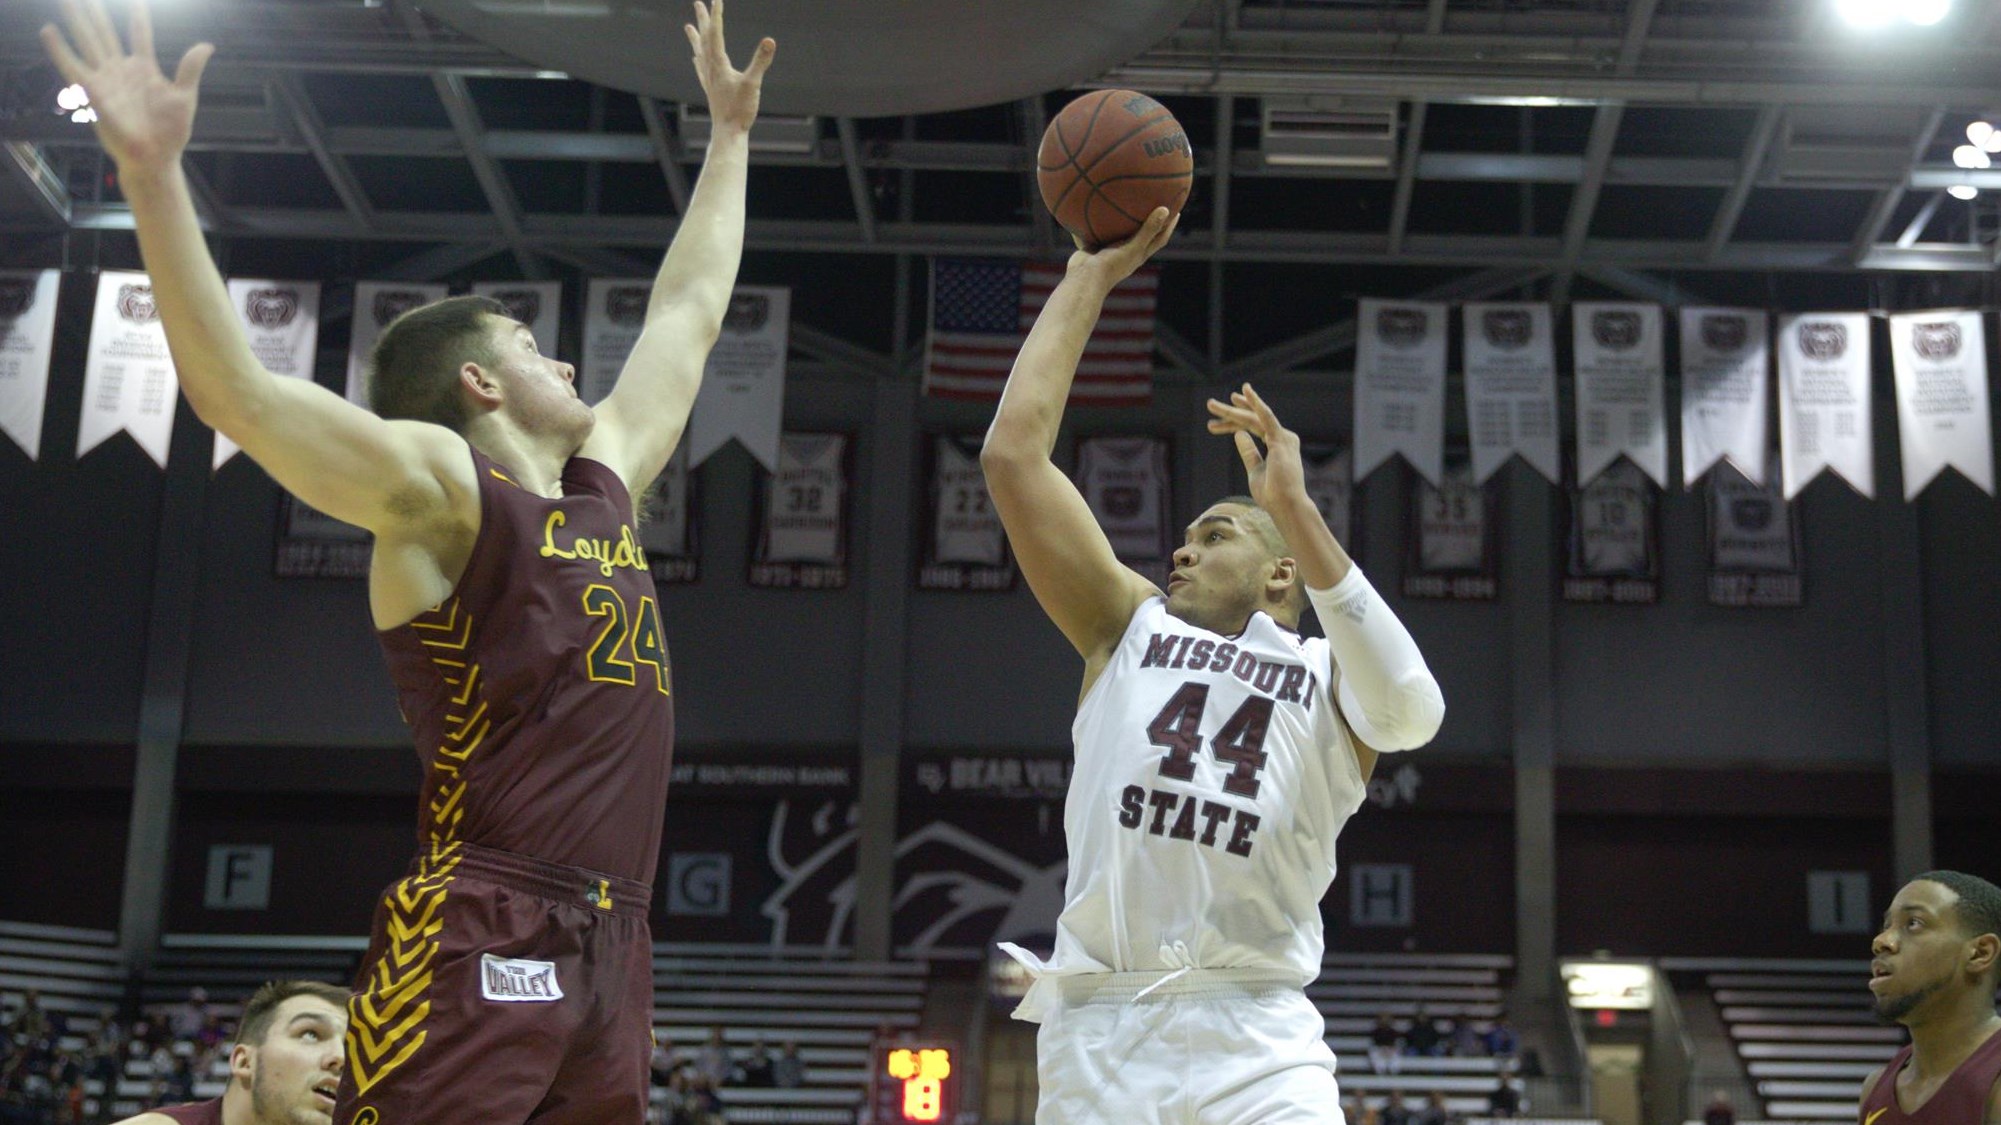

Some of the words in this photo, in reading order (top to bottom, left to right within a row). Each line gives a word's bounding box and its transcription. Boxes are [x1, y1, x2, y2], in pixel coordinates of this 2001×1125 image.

[583, 584, 669, 696] 24
[1140, 633, 1317, 712] MISSOURI
[1146, 681, 1275, 801] 44
[798, 766, 850, 786] BANK
[950, 756, 1022, 789] BEAR
[1118, 784, 1261, 858] STATE
[681, 859, 719, 909] G
[1362, 873, 1401, 919] H
[486, 961, 556, 998] VALLEY
